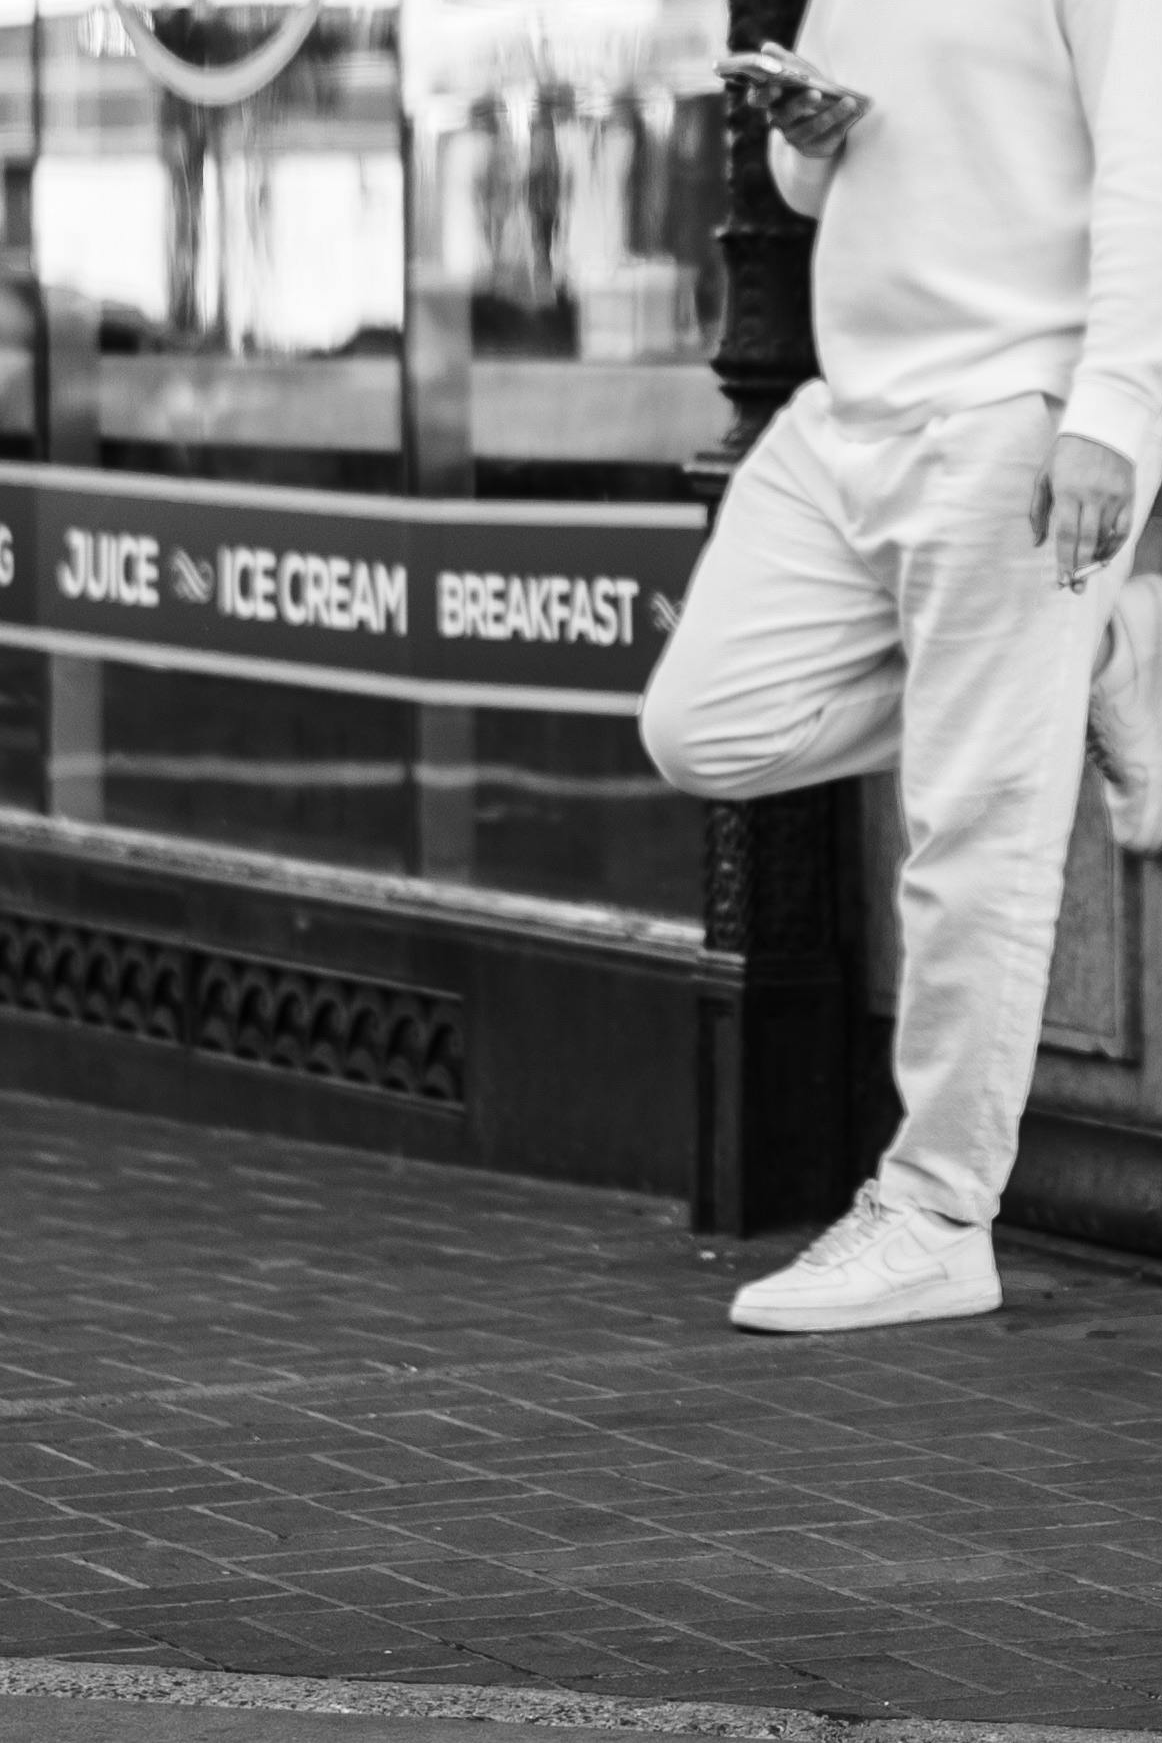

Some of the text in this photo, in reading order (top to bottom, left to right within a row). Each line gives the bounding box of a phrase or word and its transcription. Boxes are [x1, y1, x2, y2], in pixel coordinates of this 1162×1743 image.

[58, 527, 160, 608] JUICE
[218, 543, 277, 623] ICE
[278, 550, 408, 636] CREAM
[437, 572, 640, 646] BREAKFAST
